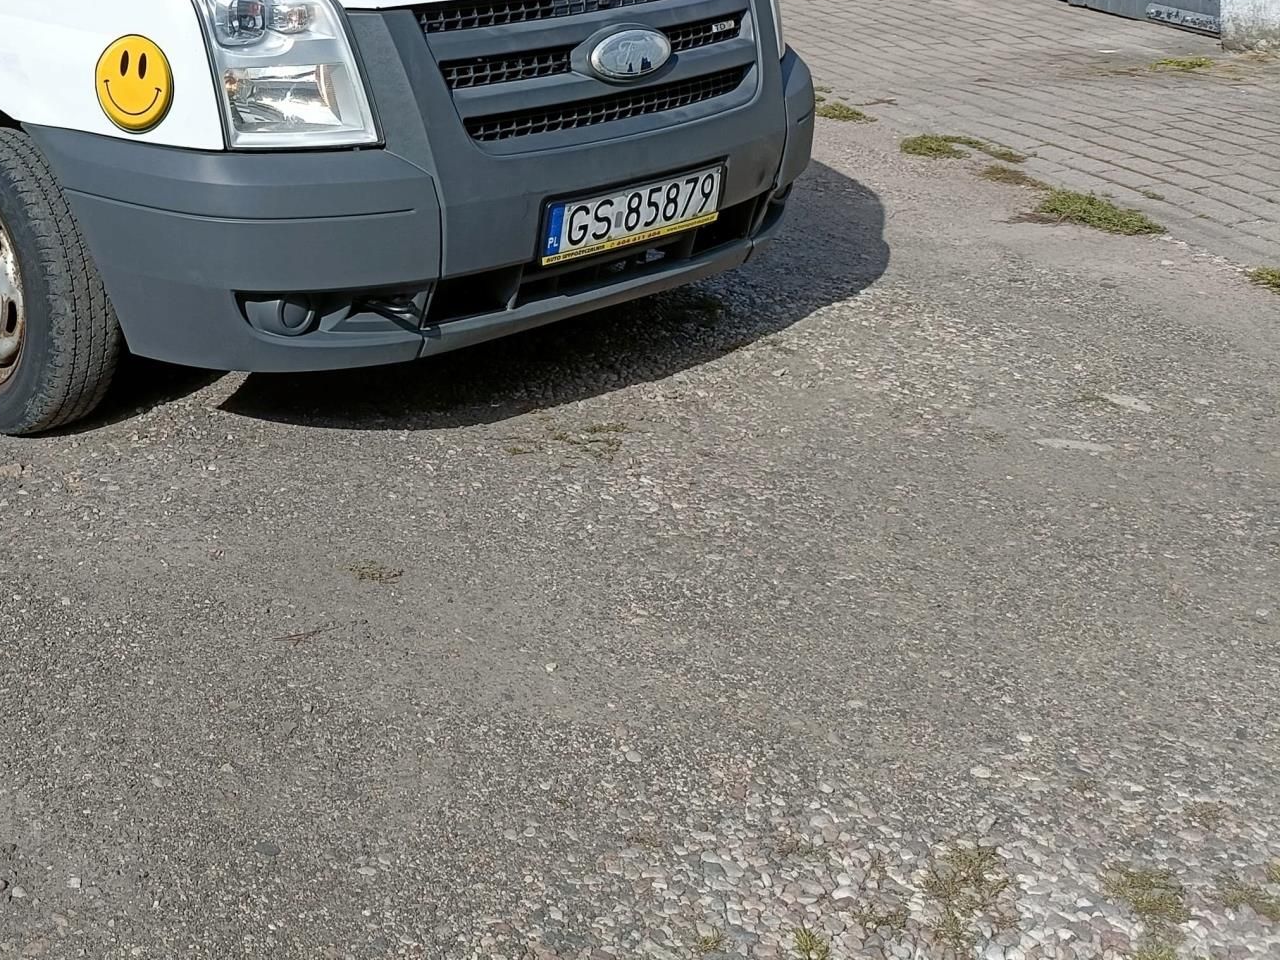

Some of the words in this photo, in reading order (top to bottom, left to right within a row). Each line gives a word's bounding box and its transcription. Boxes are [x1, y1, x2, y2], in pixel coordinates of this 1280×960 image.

[567, 199, 614, 246] GS
[624, 173, 714, 232] 85879
[547, 237, 559, 249] PL
